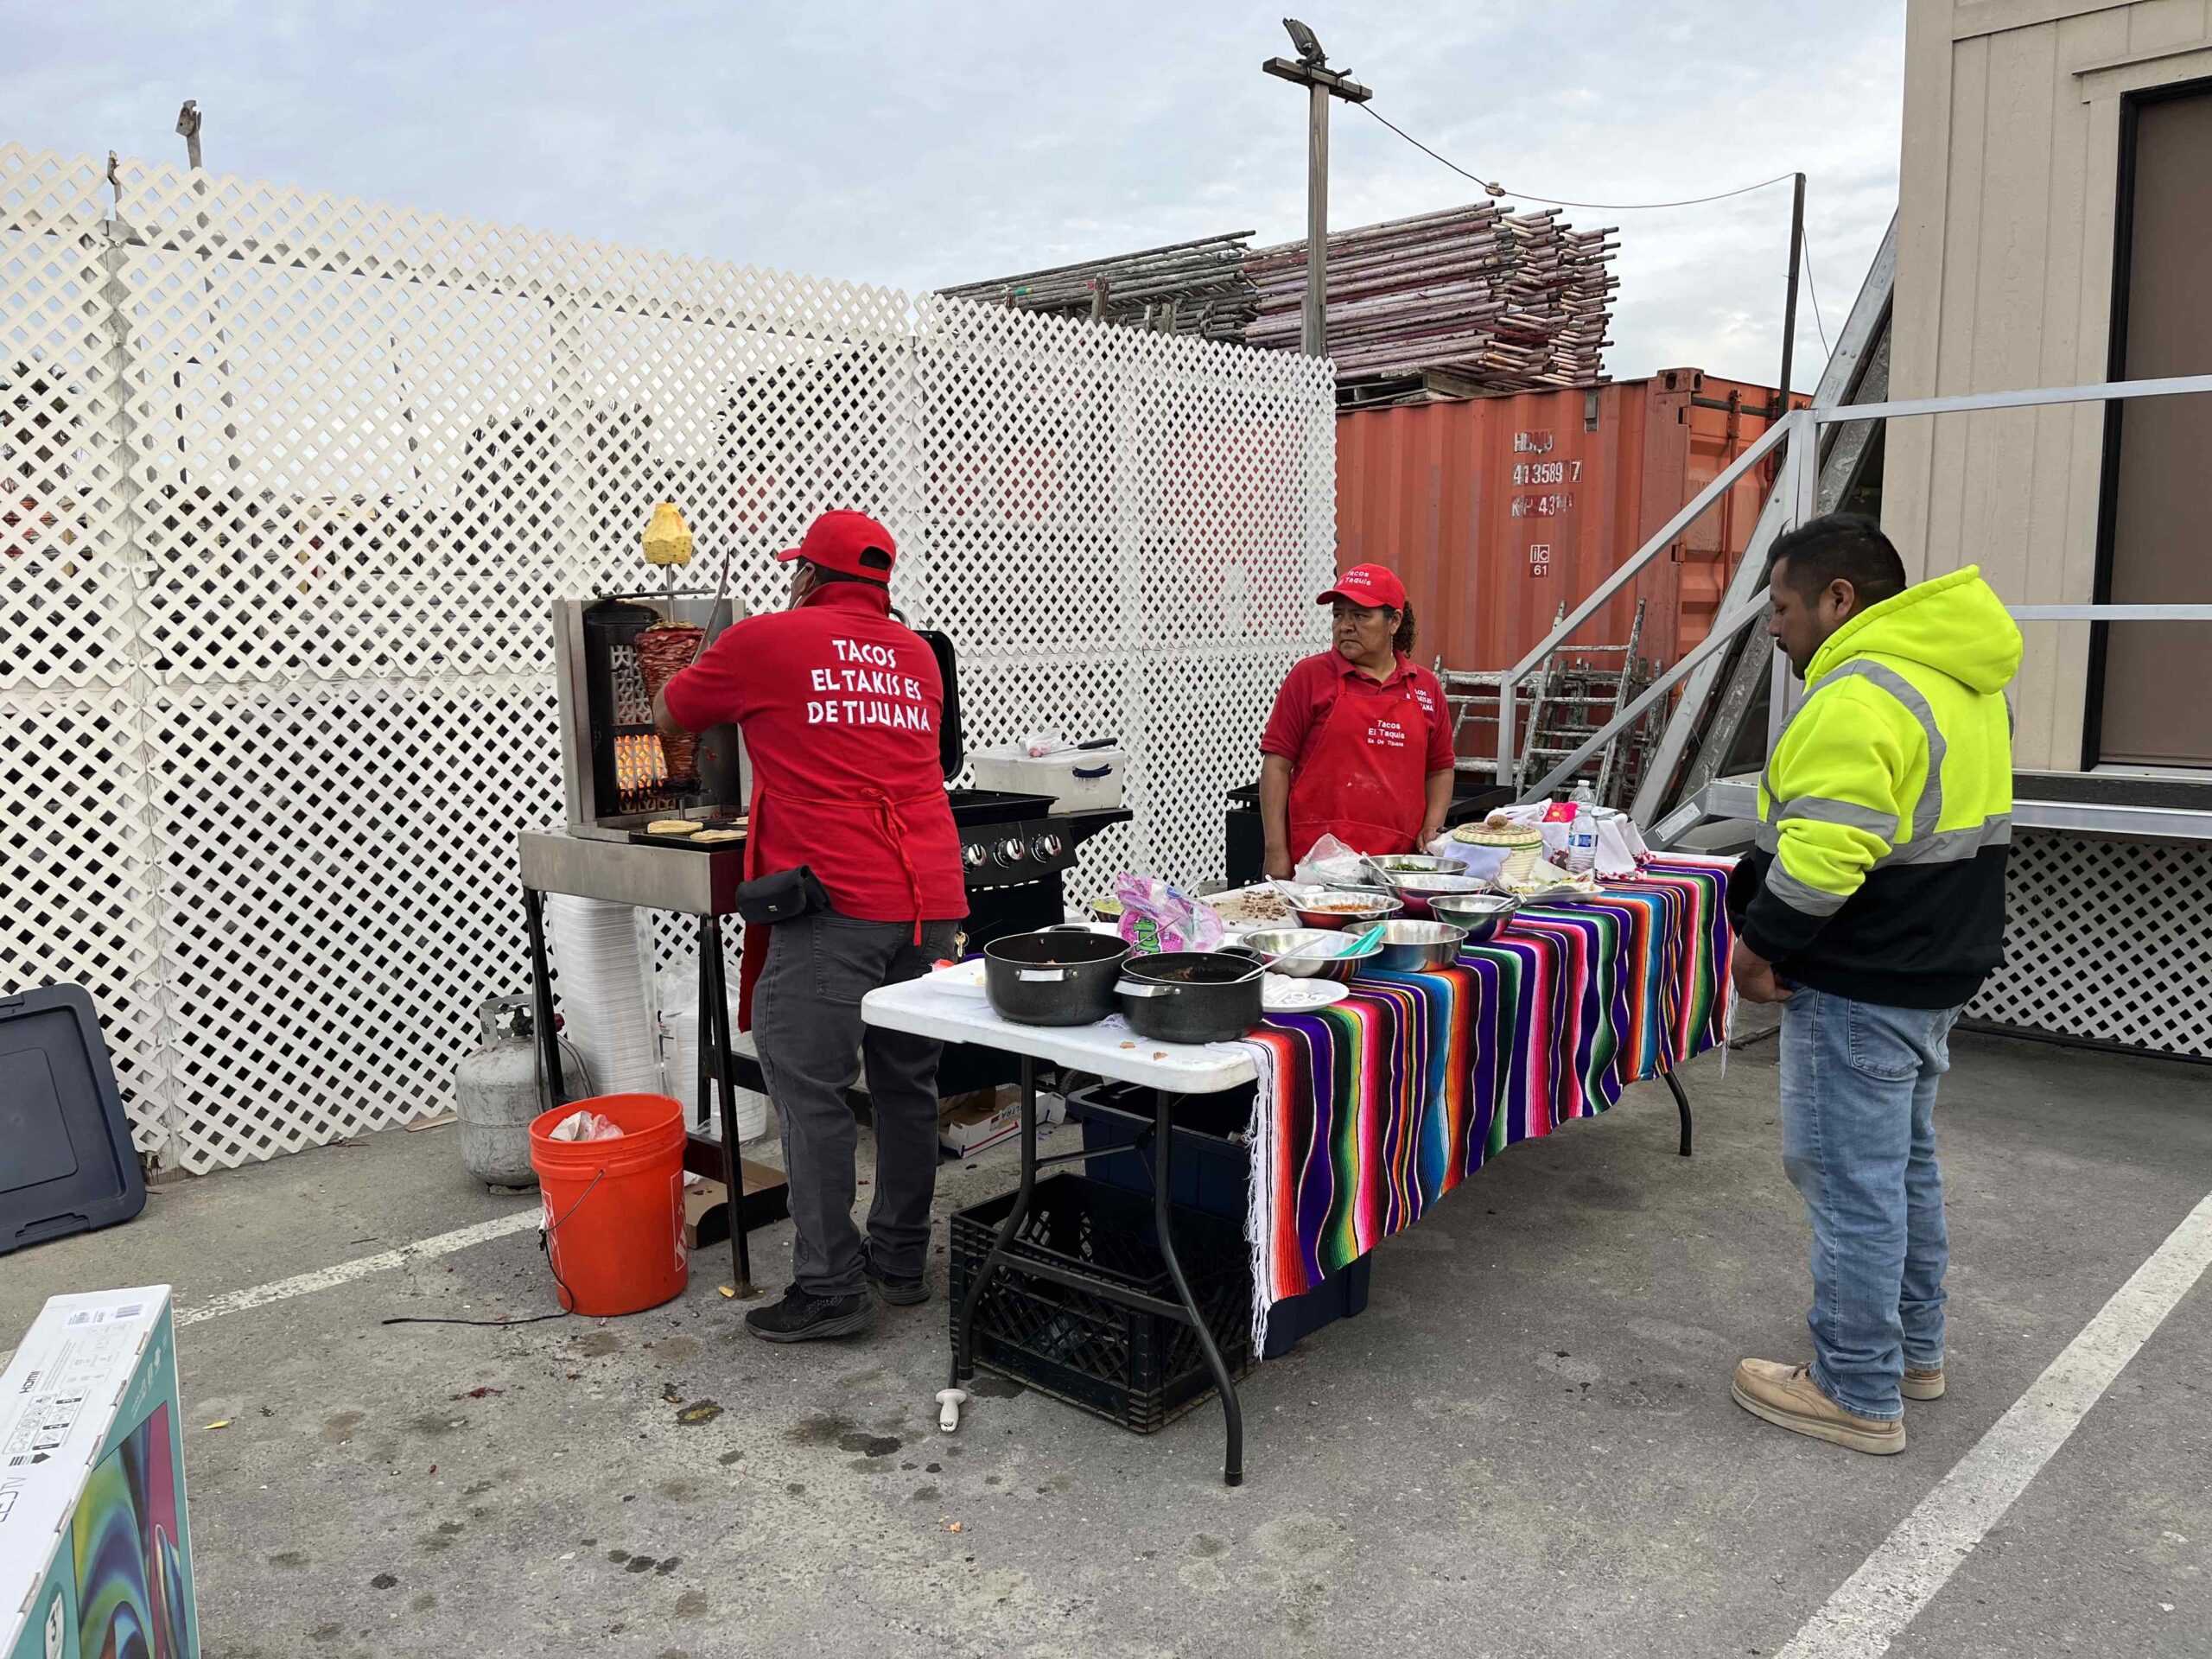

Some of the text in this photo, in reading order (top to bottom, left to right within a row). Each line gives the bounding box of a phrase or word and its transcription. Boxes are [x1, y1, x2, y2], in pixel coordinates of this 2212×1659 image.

[1513, 461, 1581, 484] 413589 7
[1533, 565, 1548, 575] 61
[832, 639, 897, 669] TACOS
[810, 668, 922, 701] EL TAKIS ES
[807, 700, 931, 732] DE TIJUANA
[1377, 719, 1401, 729] Tacos
[1368, 728, 1405, 740] El Taquis
[1001, 1105, 1021, 1119] LTRA
[19, 1370, 41, 1394] HDMI
